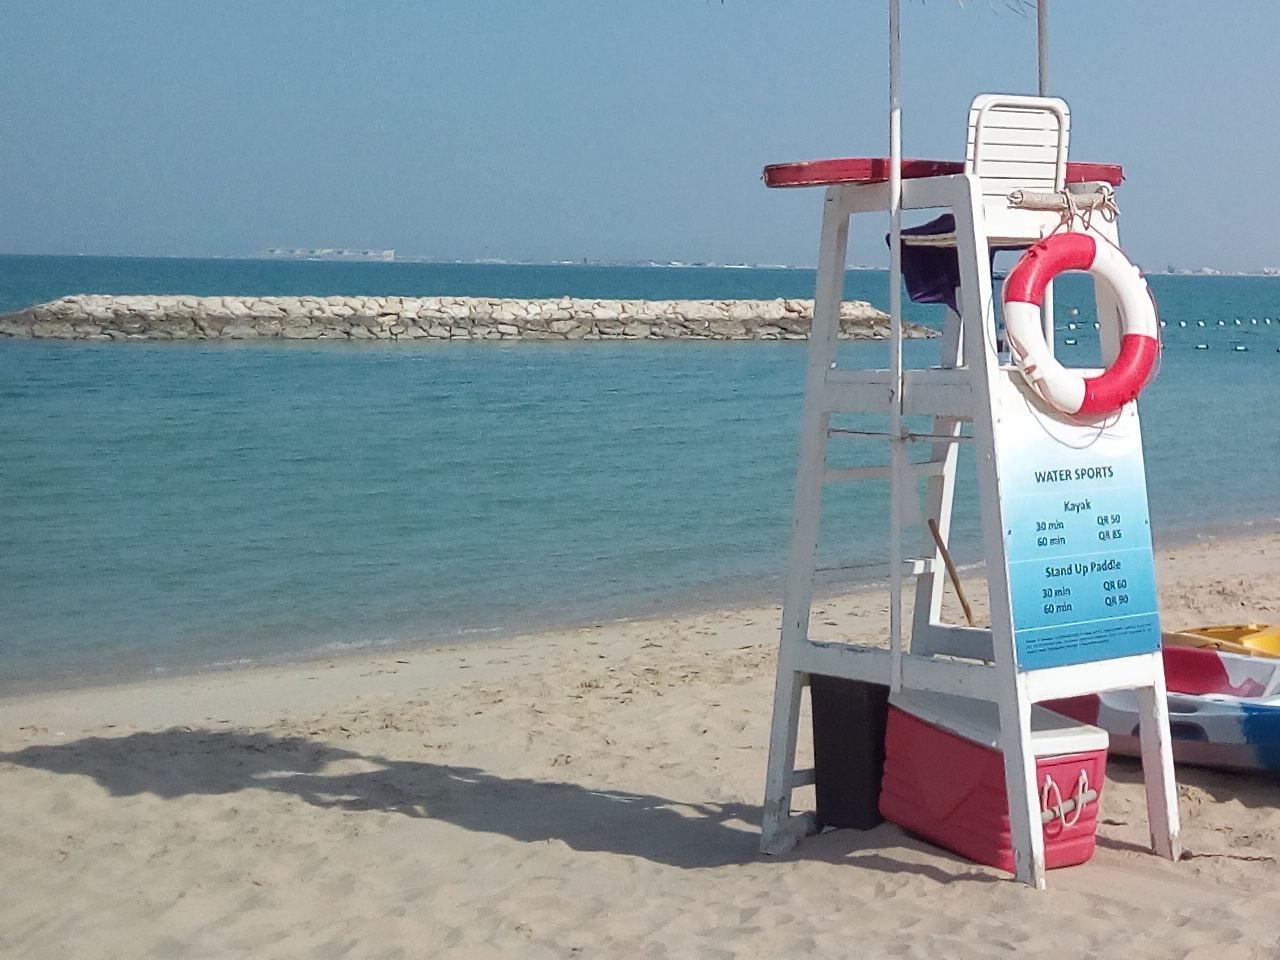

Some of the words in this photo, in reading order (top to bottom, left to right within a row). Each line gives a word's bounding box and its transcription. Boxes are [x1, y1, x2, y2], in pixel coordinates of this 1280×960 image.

[1034, 469, 1072, 483] WATER
[1074, 466, 1114, 480] SPORTS
[1063, 498, 1091, 513] Kayak
[1048, 519, 1064, 530] min
[1097, 515, 1109, 526] QR
[1098, 530, 1110, 541] QR
[1045, 563, 1072, 578] Stand
[1074, 563, 1088, 576] Up
[1090, 559, 1121, 573] Paddle
[1042, 588, 1053, 598] 30
[1054, 586, 1071, 597] min
[1103, 580, 1116, 591] QR
[1043, 604, 1054, 614] 60
[1056, 601, 1072, 613] min
[1105, 596, 1117, 607] QR
